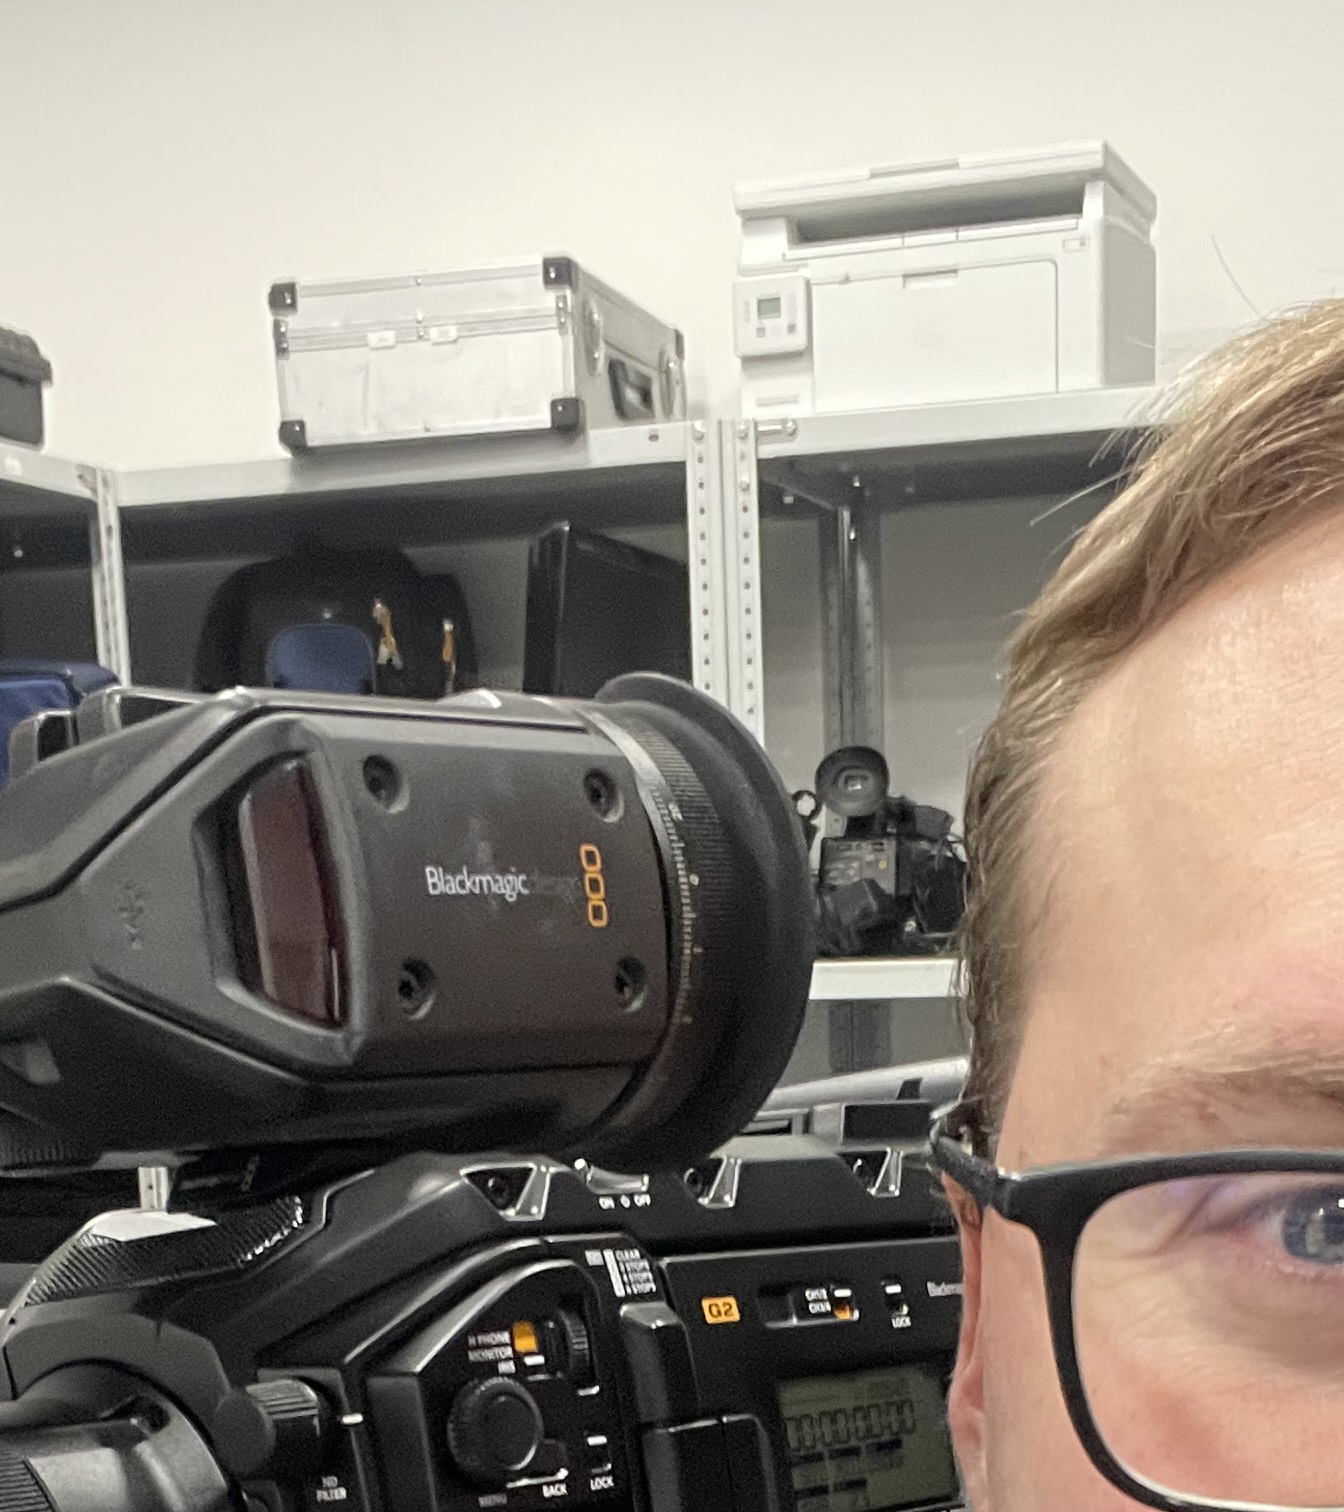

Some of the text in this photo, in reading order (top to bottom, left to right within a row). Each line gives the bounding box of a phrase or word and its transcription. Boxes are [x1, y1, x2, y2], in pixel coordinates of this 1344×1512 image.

[708, 1301, 734, 1317] G2
[590, 1476, 614, 1490] LOCK
[542, 1484, 568, 1498] BACK
